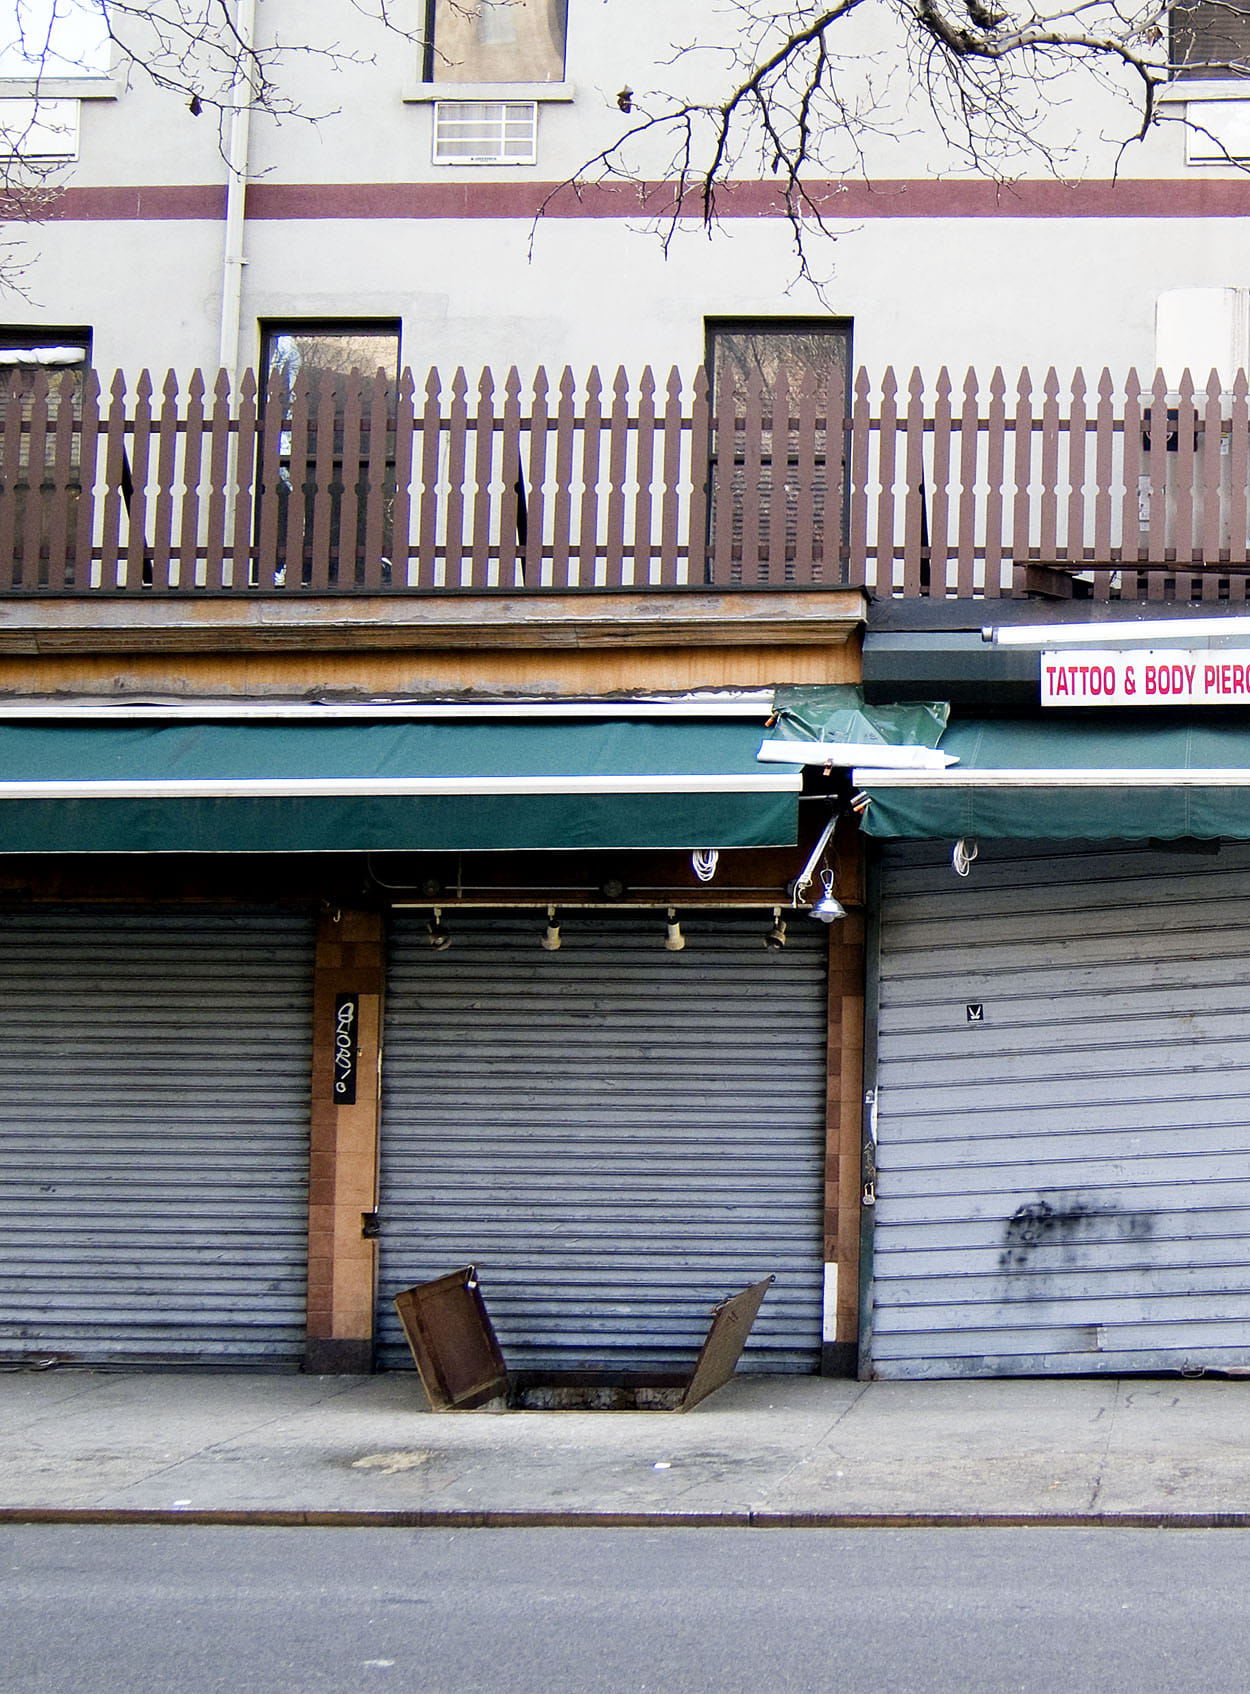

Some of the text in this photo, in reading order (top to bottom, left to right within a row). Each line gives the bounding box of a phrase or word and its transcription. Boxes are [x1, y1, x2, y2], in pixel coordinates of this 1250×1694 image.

[1046, 665, 1116, 697] TATTOO
[1124, 665, 1136, 695] &
[1145, 664, 1197, 695] BODY
